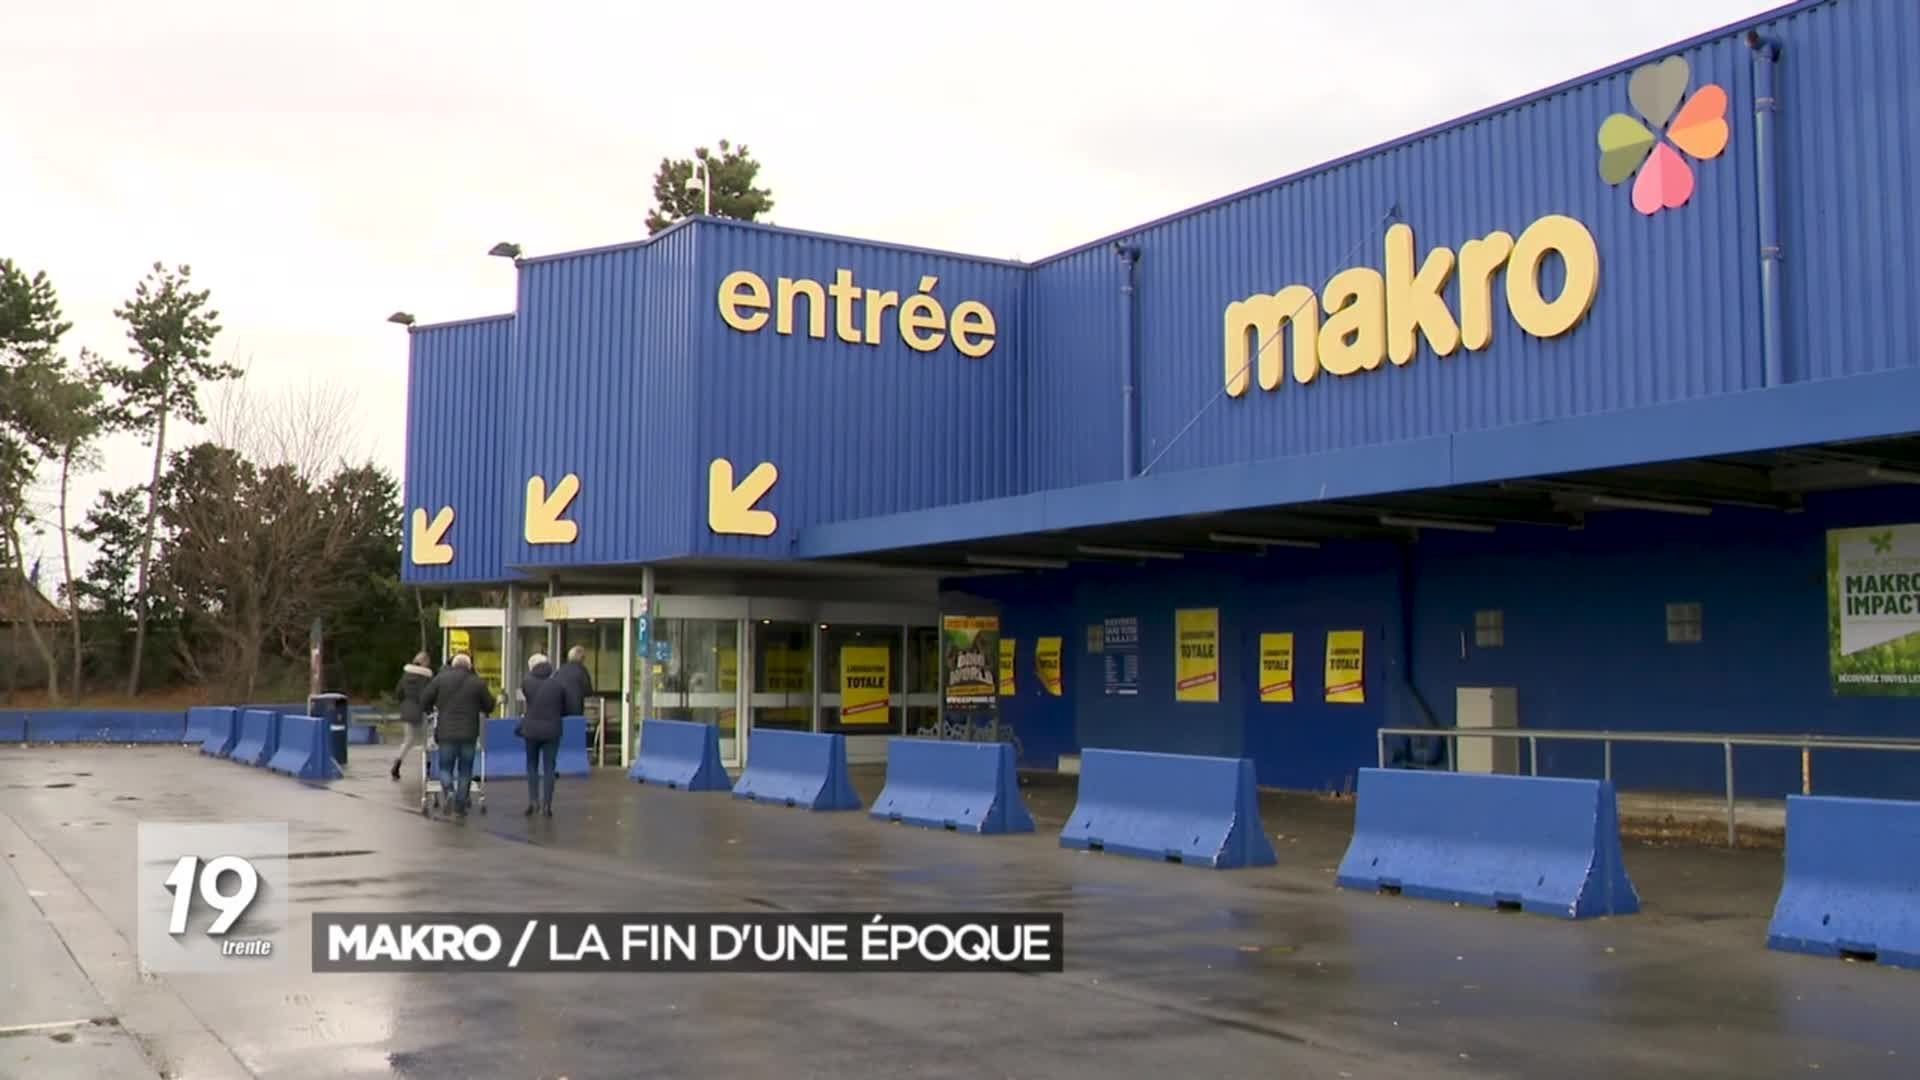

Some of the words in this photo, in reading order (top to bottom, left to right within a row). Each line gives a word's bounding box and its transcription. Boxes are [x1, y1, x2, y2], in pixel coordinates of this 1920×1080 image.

[718, 268, 997, 358] entrée
[1225, 214, 1599, 398] makro
[1181, 643, 1215, 658] TOTALE
[1263, 659, 1289, 671] TOTALE
[1329, 658, 1360, 671] TOTALE
[846, 676, 885, 689] TOTALE
